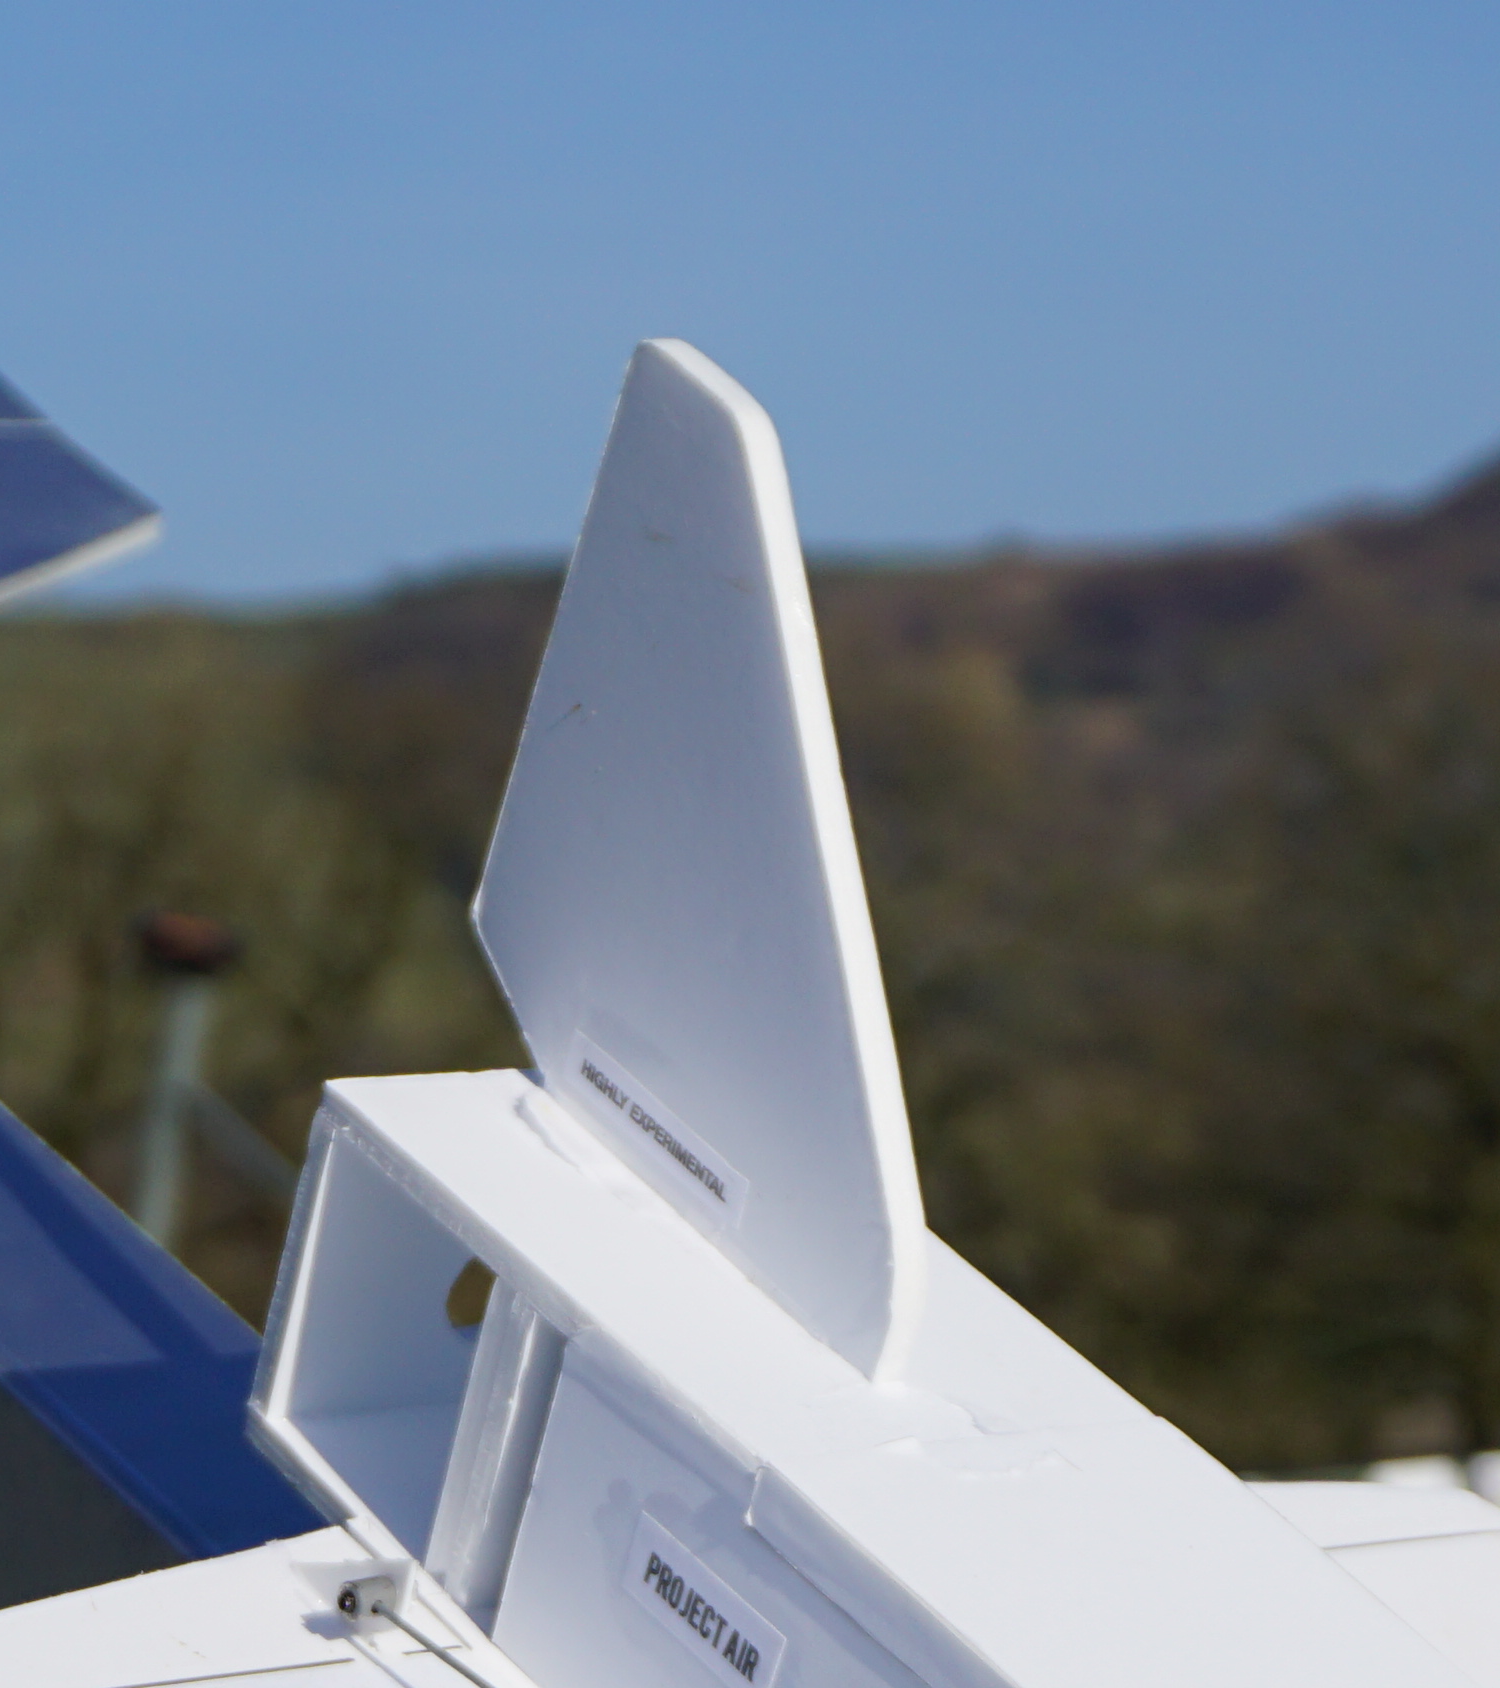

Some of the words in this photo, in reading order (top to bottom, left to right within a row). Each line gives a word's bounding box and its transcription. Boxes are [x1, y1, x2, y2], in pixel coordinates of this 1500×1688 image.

[580, 1058, 630, 1110] HIGHLY
[629, 1102, 726, 1202] EXPERIMENTAL
[643, 1552, 728, 1649] PROJECT
[722, 1629, 759, 1682] AIR
